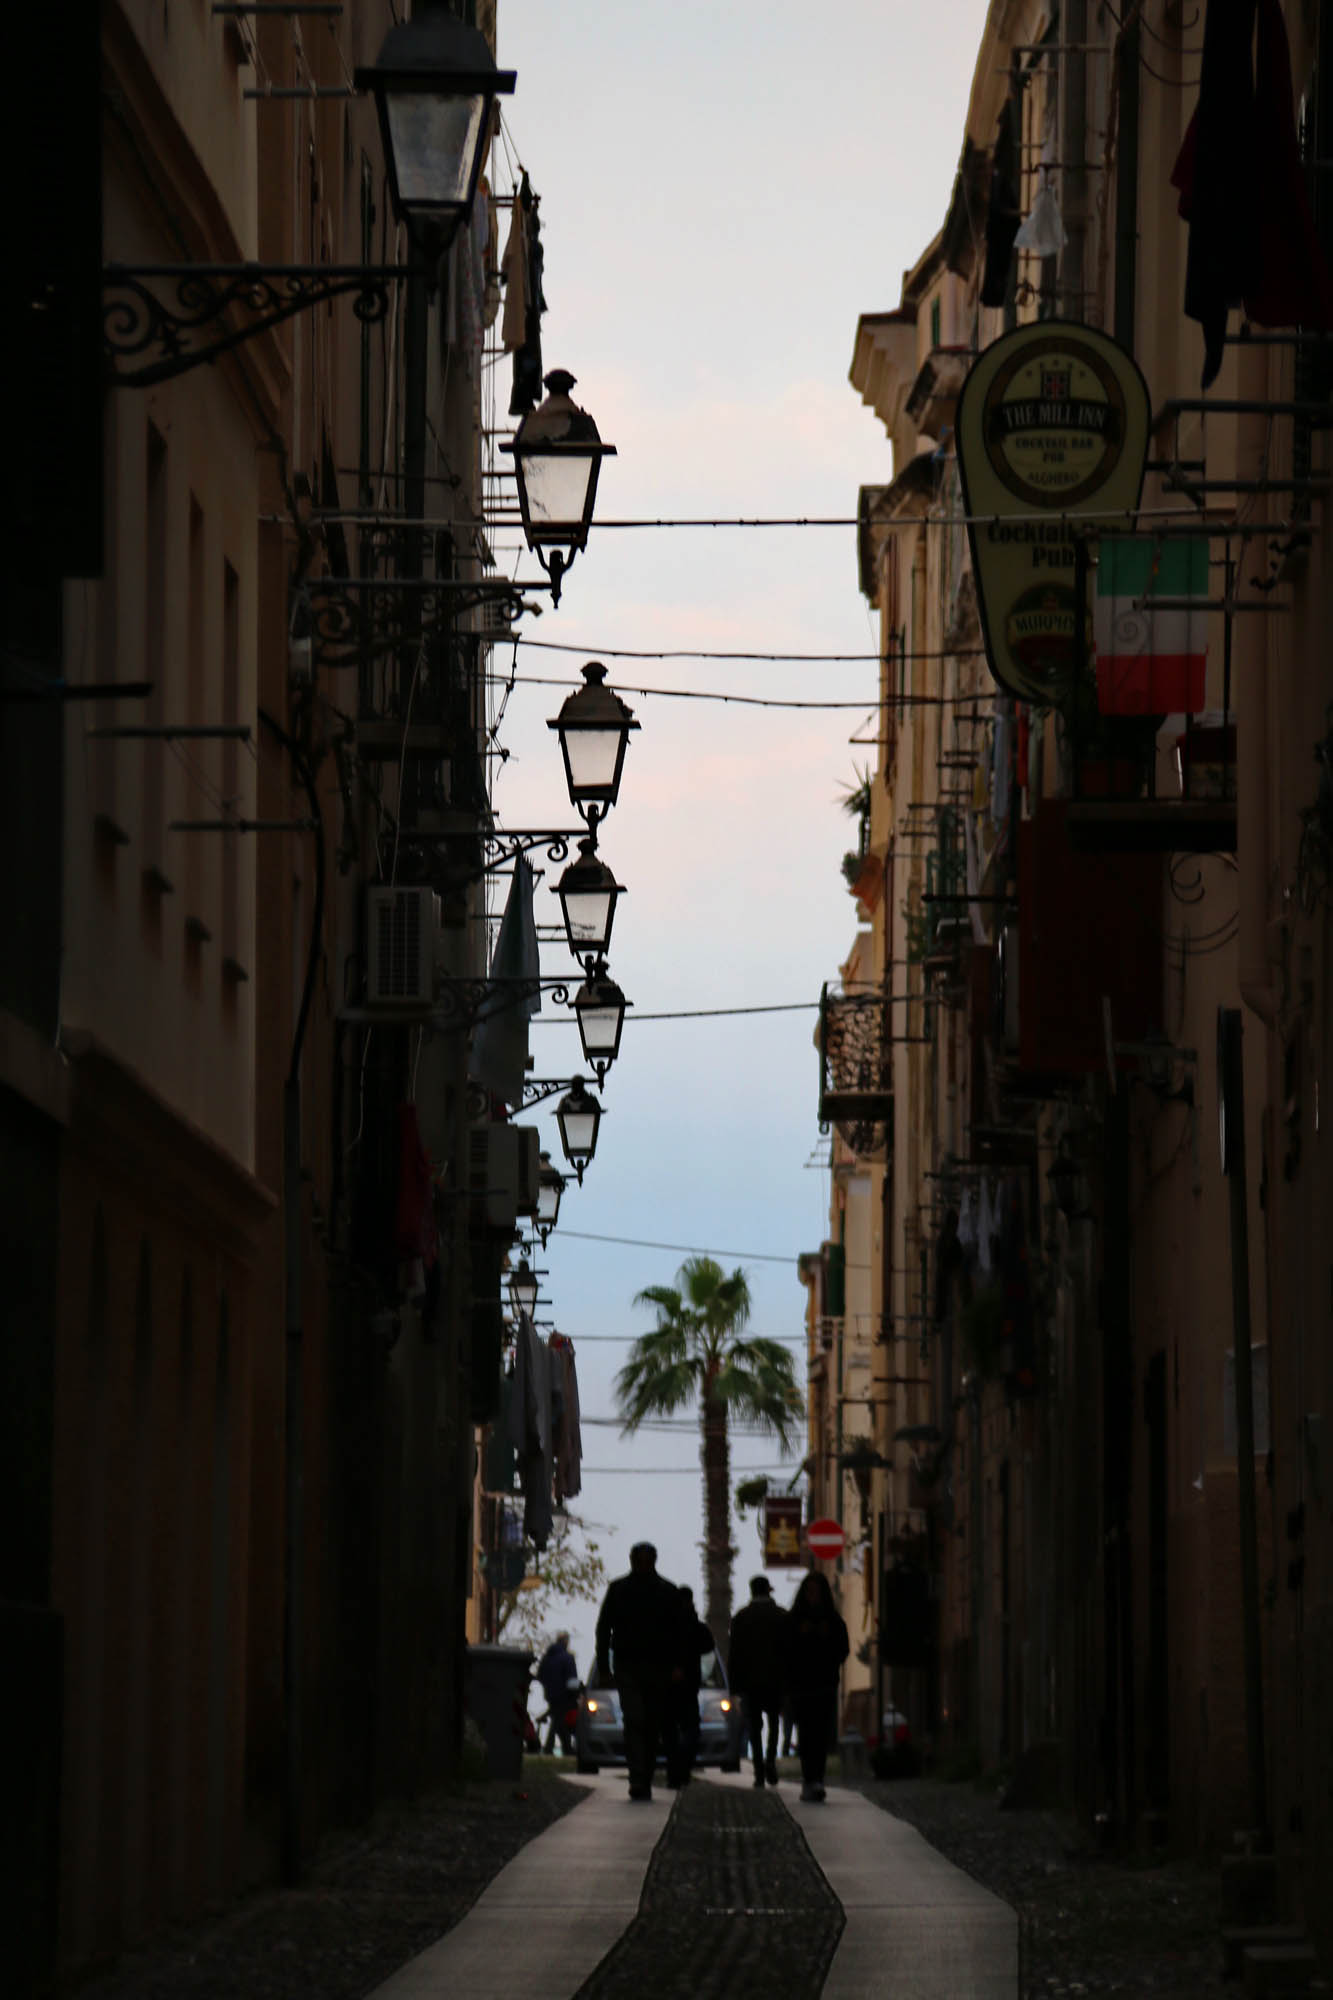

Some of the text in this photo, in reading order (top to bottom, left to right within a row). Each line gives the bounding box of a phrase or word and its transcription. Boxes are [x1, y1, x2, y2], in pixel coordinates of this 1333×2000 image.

[1002, 402, 1106, 430] THE MILL INN
[986, 520, 1073, 543] Cocktail
[1032, 546, 1075, 568] Pub
